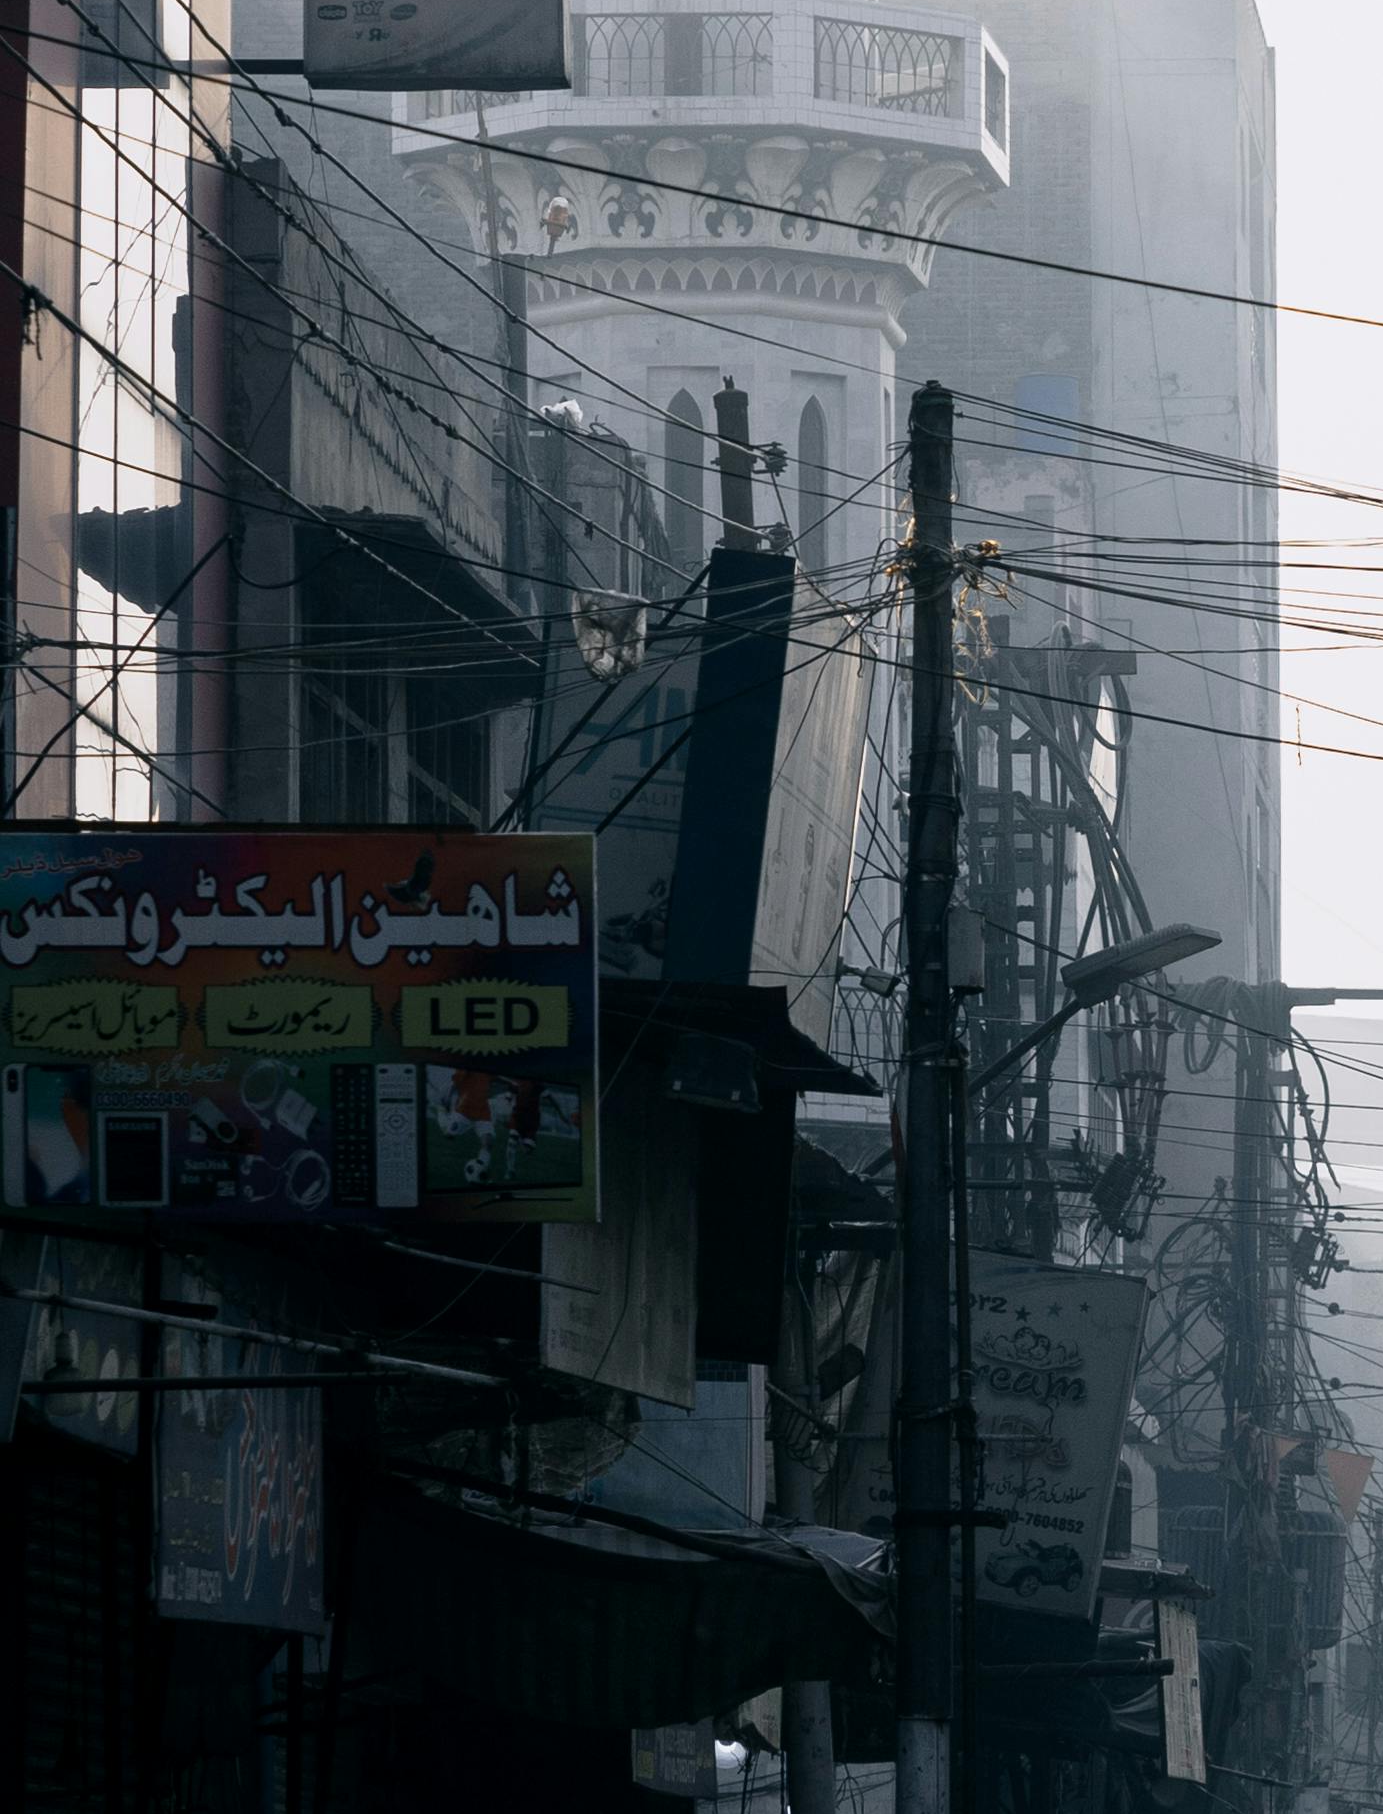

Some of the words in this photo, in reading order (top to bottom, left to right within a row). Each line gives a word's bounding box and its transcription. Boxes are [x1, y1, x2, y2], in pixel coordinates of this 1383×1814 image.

[608, 787, 681, 808] QALIT
[97, 988, 177, 1045] موبائل
[430, 997, 541, 1036] LED
[969, 1360, 1089, 1404] ream
